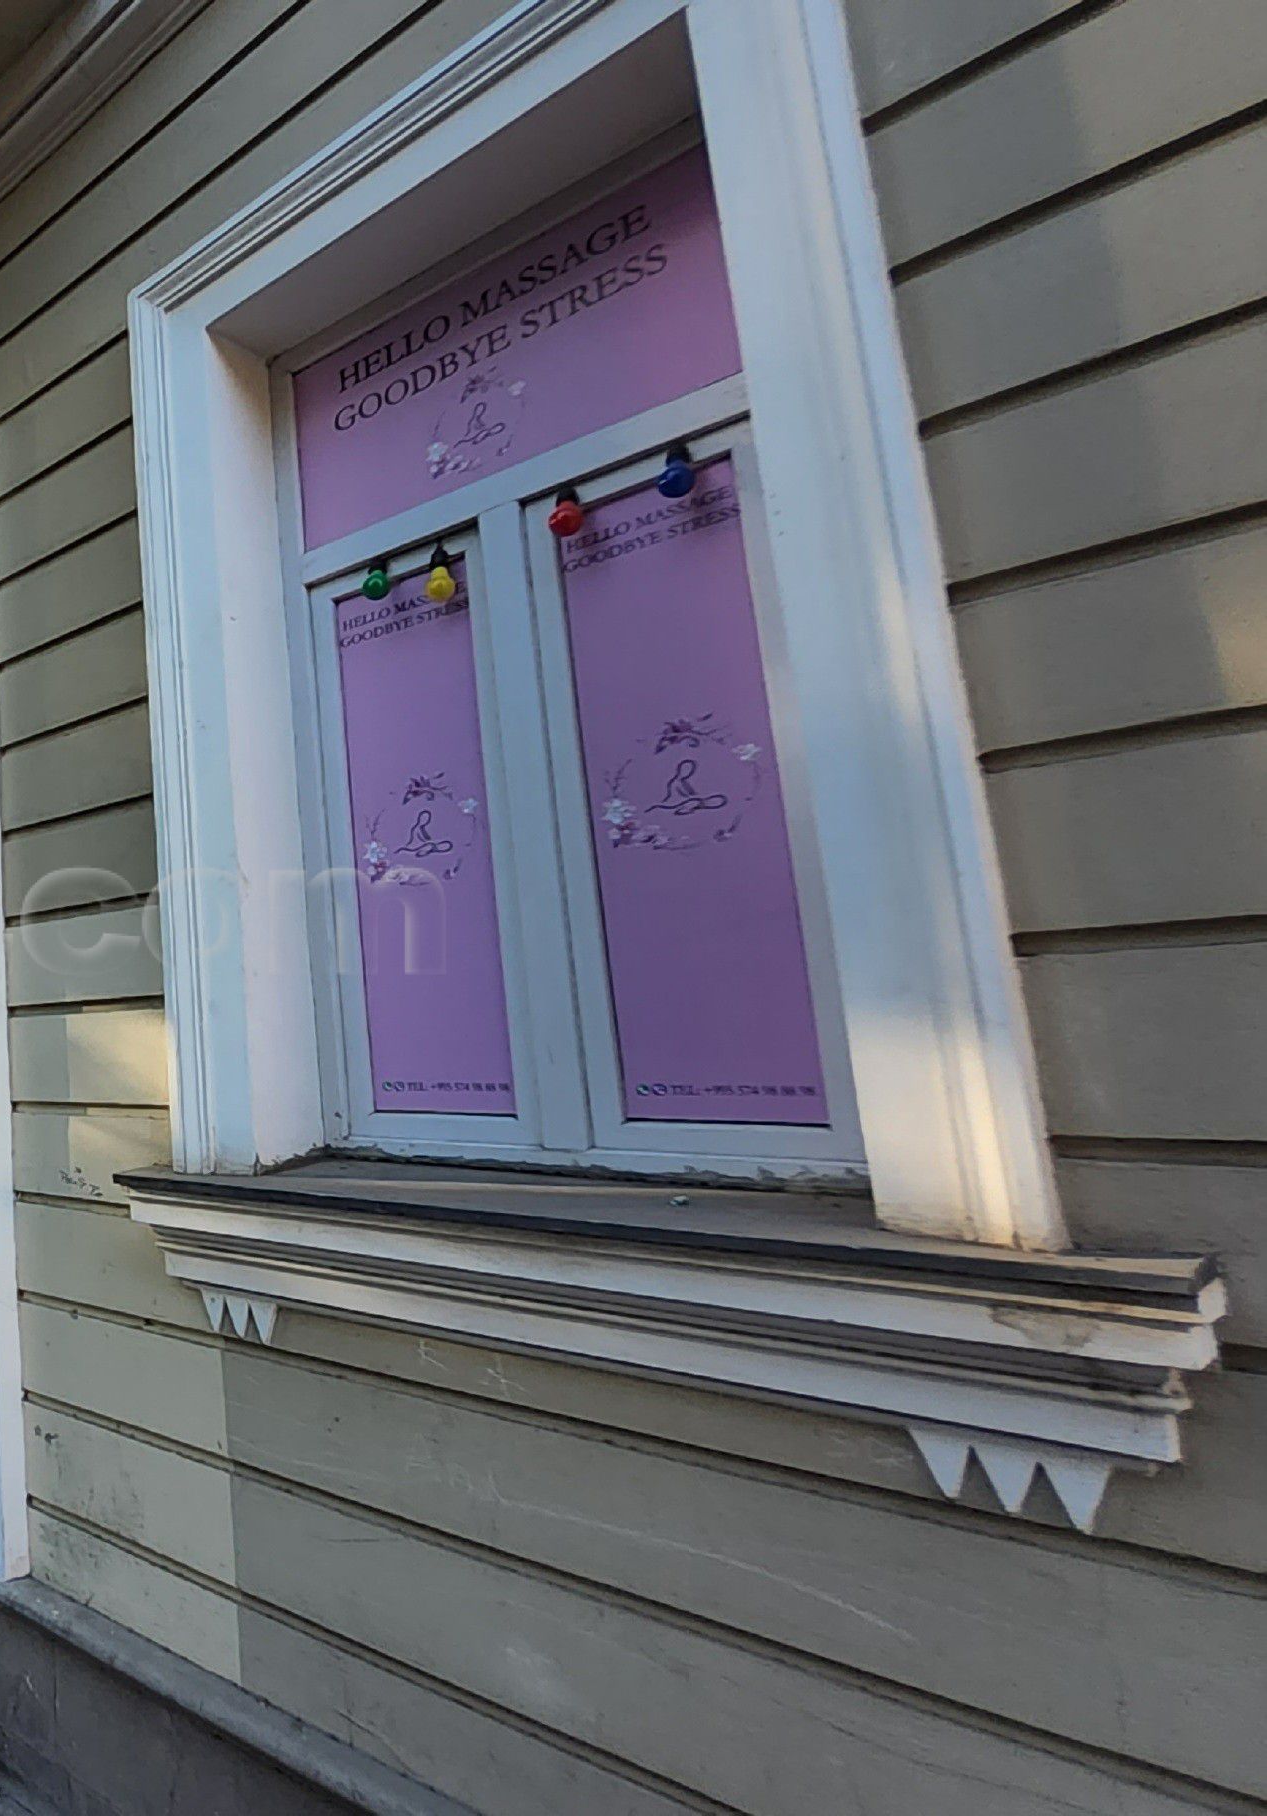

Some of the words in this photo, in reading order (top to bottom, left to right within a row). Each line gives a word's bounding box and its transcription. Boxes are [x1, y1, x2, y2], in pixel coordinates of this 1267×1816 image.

[337, 314, 451, 394] HELLO
[459, 204, 653, 328] MASSAGE
[333, 325, 512, 432] GOODBYE
[521, 244, 669, 339] STRESS
[563, 531, 663, 574] GOODBYE
[666, 503, 742, 539] STRESS
[566, 521, 631, 554] HELLO
[340, 616, 415, 648] GOODBYE
[342, 607, 391, 632] HELLO
